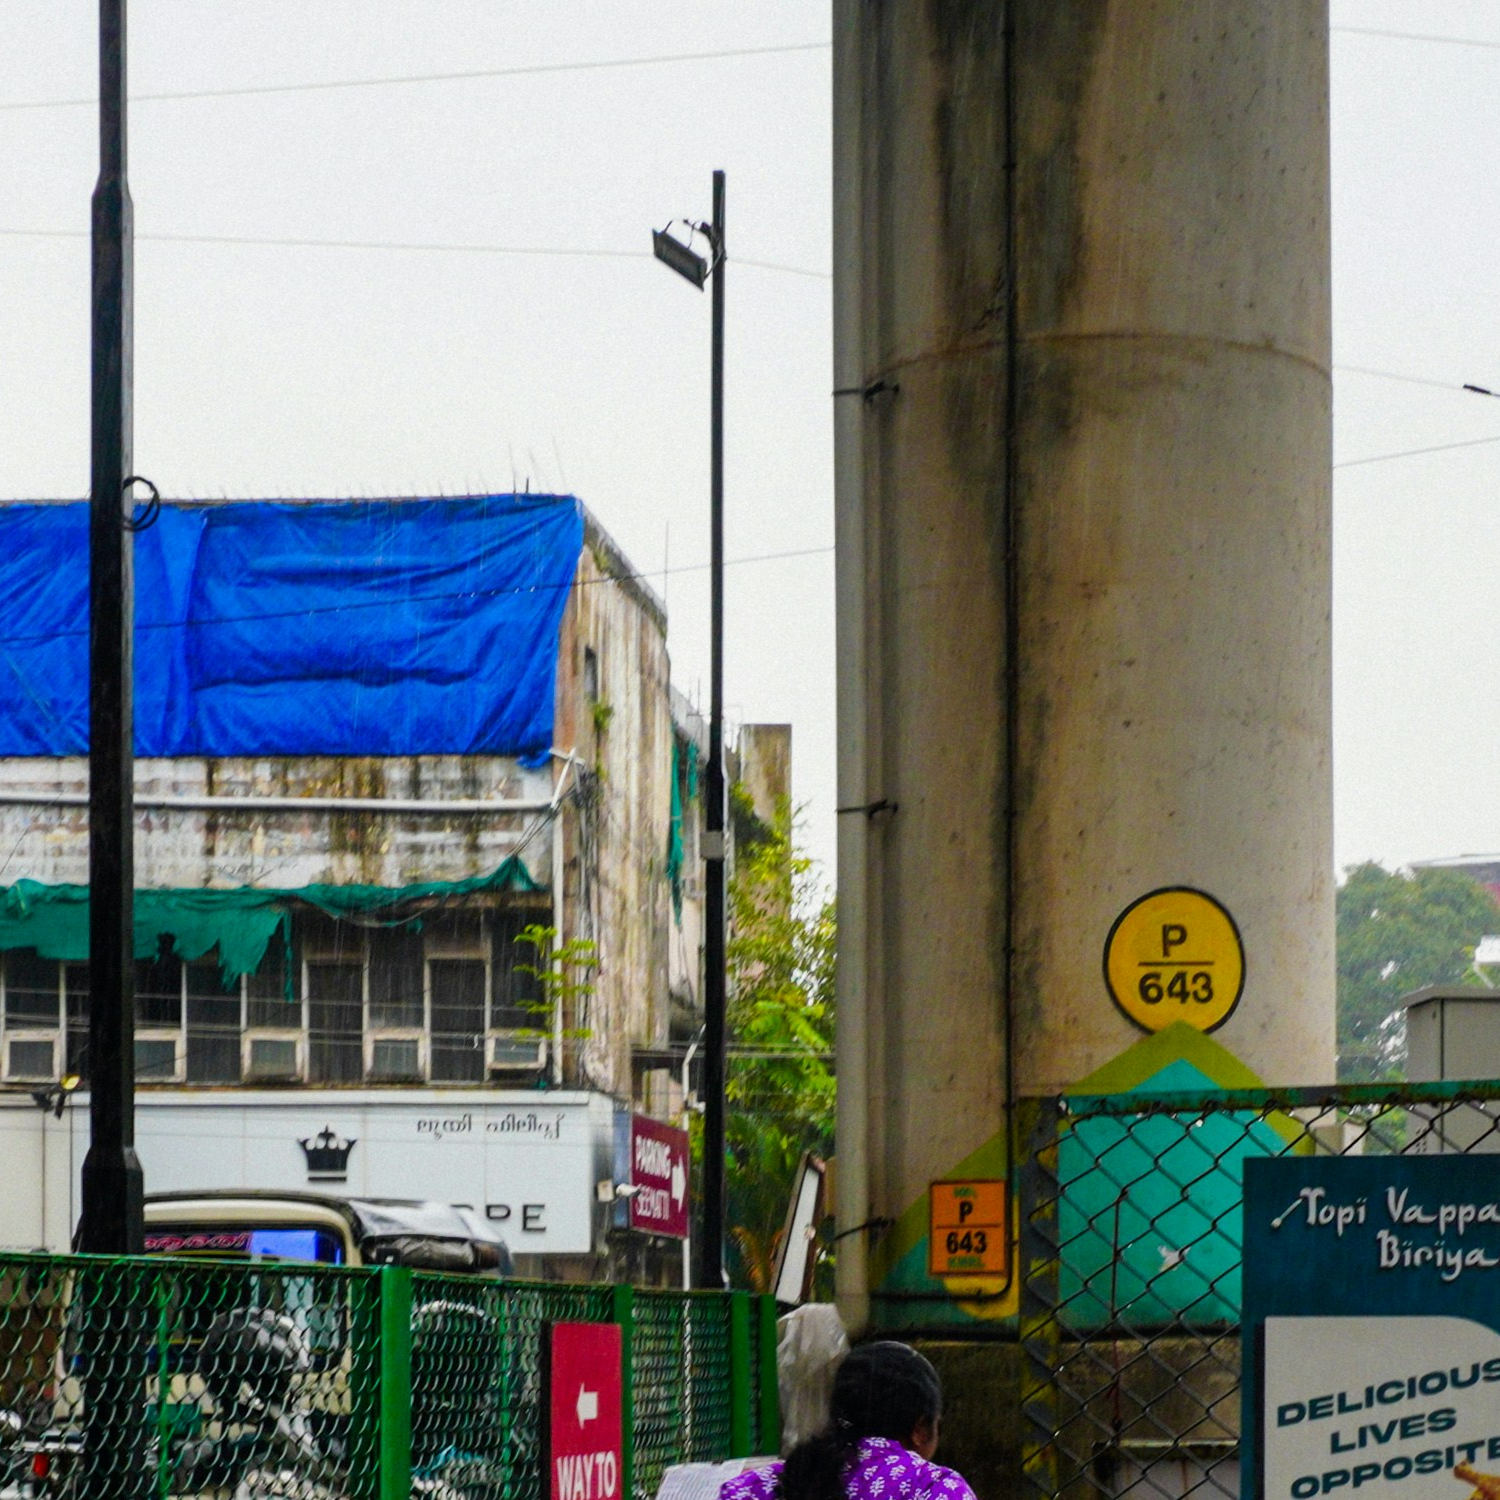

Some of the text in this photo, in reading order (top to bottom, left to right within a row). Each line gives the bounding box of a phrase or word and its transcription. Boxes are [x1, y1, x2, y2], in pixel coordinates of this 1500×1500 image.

[1161, 924, 1188, 958] P
[1138, 971, 1214, 1005] 643
[635, 1134, 672, 1180] PARKING
[959, 1201, 973, 1223] P
[946, 1231, 988, 1254] 643
[1329, 1407, 1458, 1455] LIVES
[595, 1450, 617, 1499] TO
